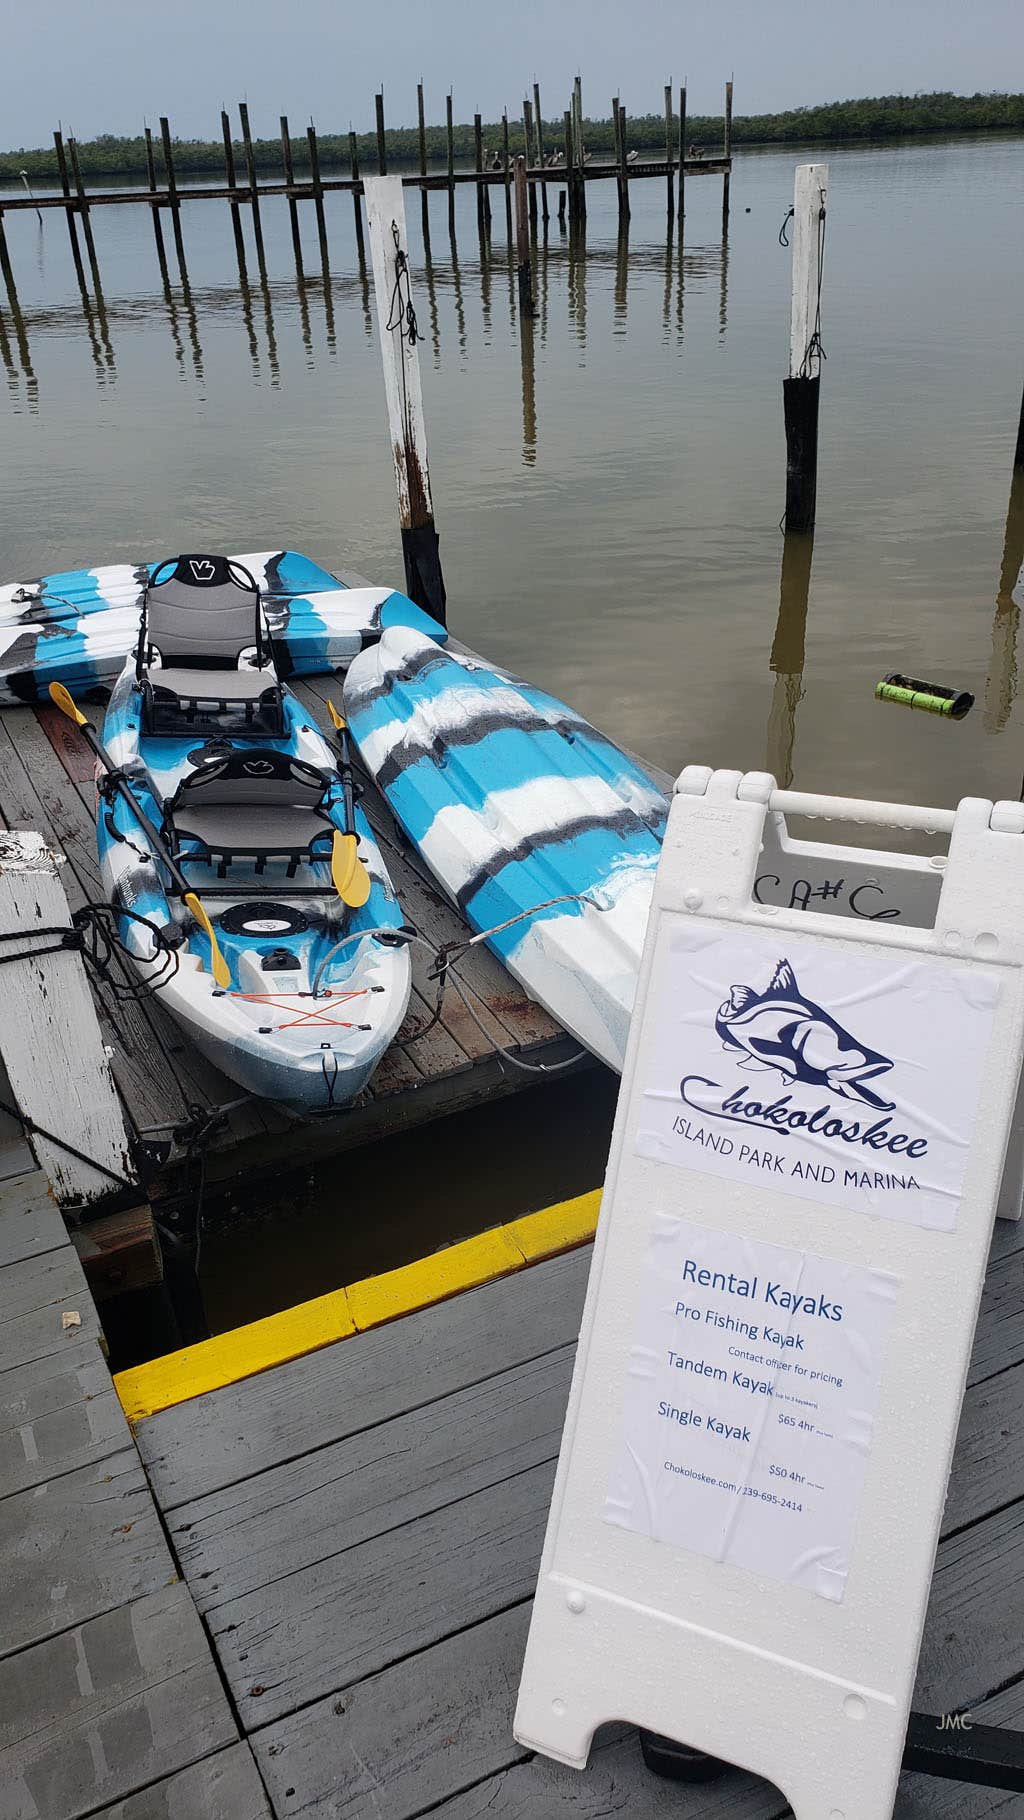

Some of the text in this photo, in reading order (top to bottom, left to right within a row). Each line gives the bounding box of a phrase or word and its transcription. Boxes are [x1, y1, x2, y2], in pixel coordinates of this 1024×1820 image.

[680, 1075, 928, 1159] Chokoloskee
[672, 1115, 921, 1191] ISLAND PARK AND MARINA
[682, 1259, 843, 1322] Rental Kayaks
[675, 1301, 805, 1351] Pro Fishing Kayak
[667, 1351, 728, 1382] Tandem
[732, 1370, 774, 1396] Kayak
[728, 1346, 764, 1364] Contact
[794, 1363, 809, 1375] for
[810, 1369, 844, 1388] pricing
[658, 1401, 751, 1442] Single Kayak
[778, 1413, 815, 1432] $65 4hr
[664, 1461, 737, 1492] Chokoloskee.com
[769, 1464, 806, 1484] $50 4hr
